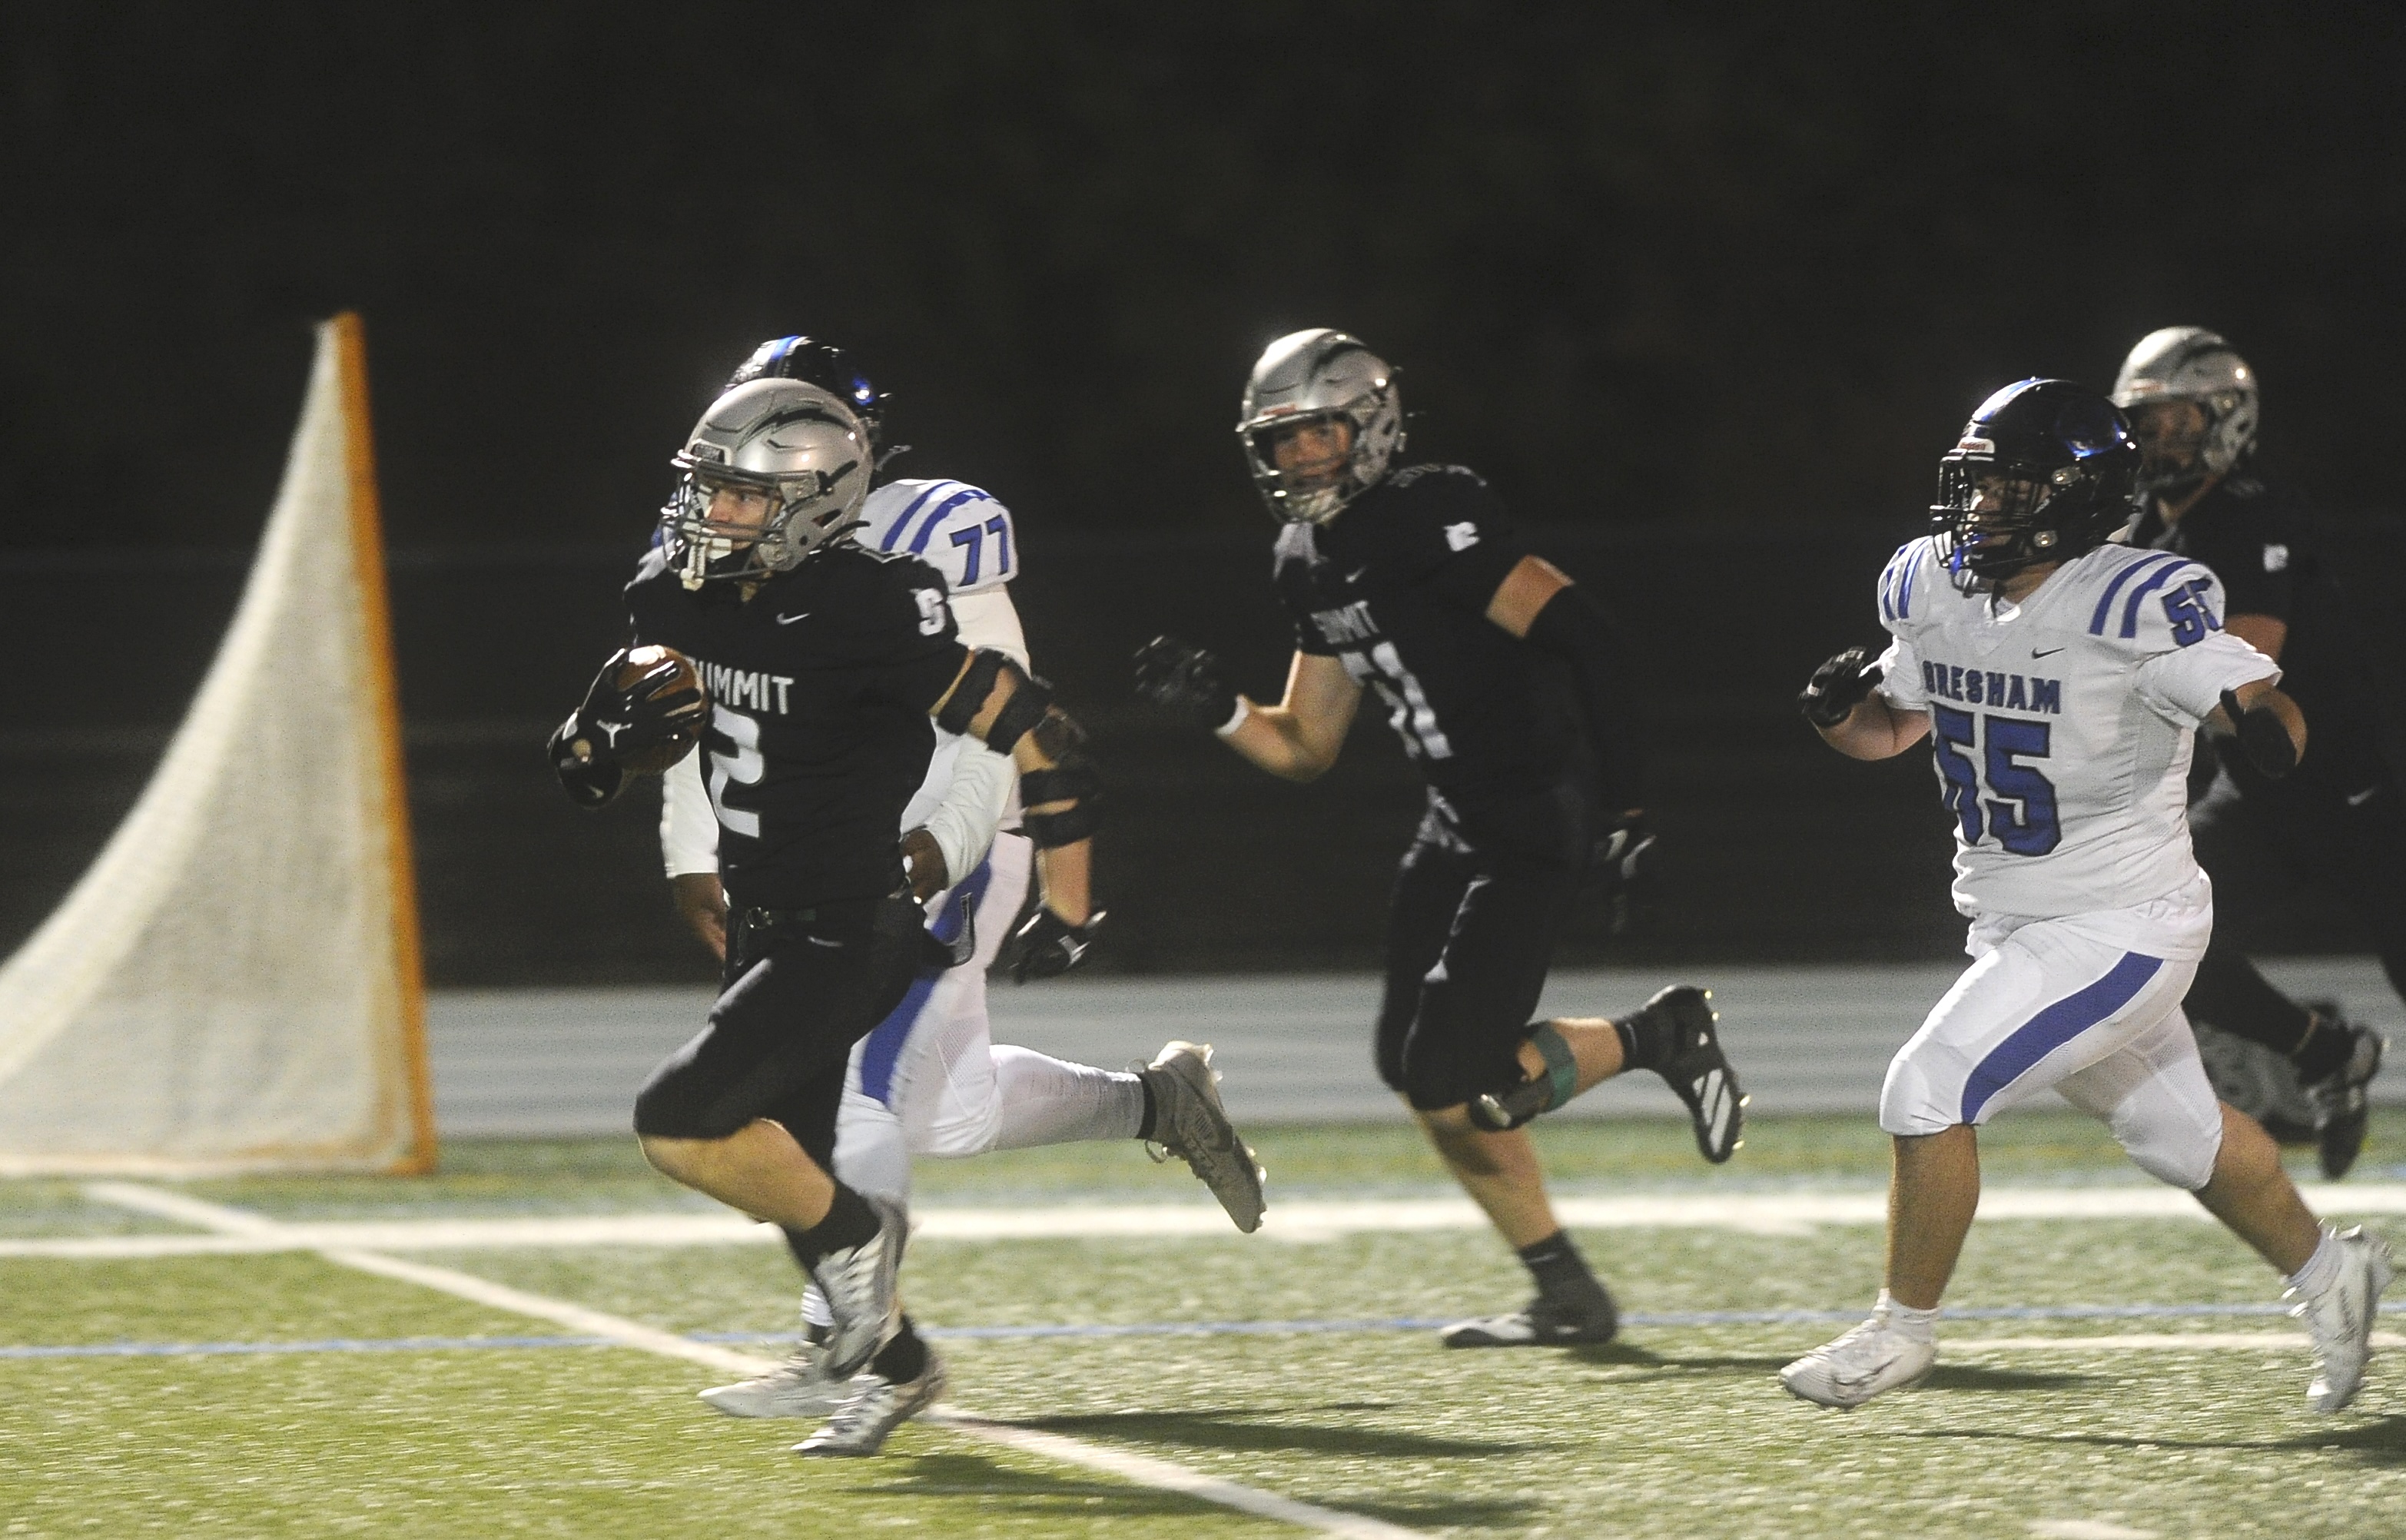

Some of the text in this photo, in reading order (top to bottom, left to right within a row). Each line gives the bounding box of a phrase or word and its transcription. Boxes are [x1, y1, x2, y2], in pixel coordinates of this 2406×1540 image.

[948, 514, 1009, 588] 77
[685, 655, 795, 715] UMMIT
[709, 702, 764, 838] 2
[1931, 700, 2063, 858] 55
